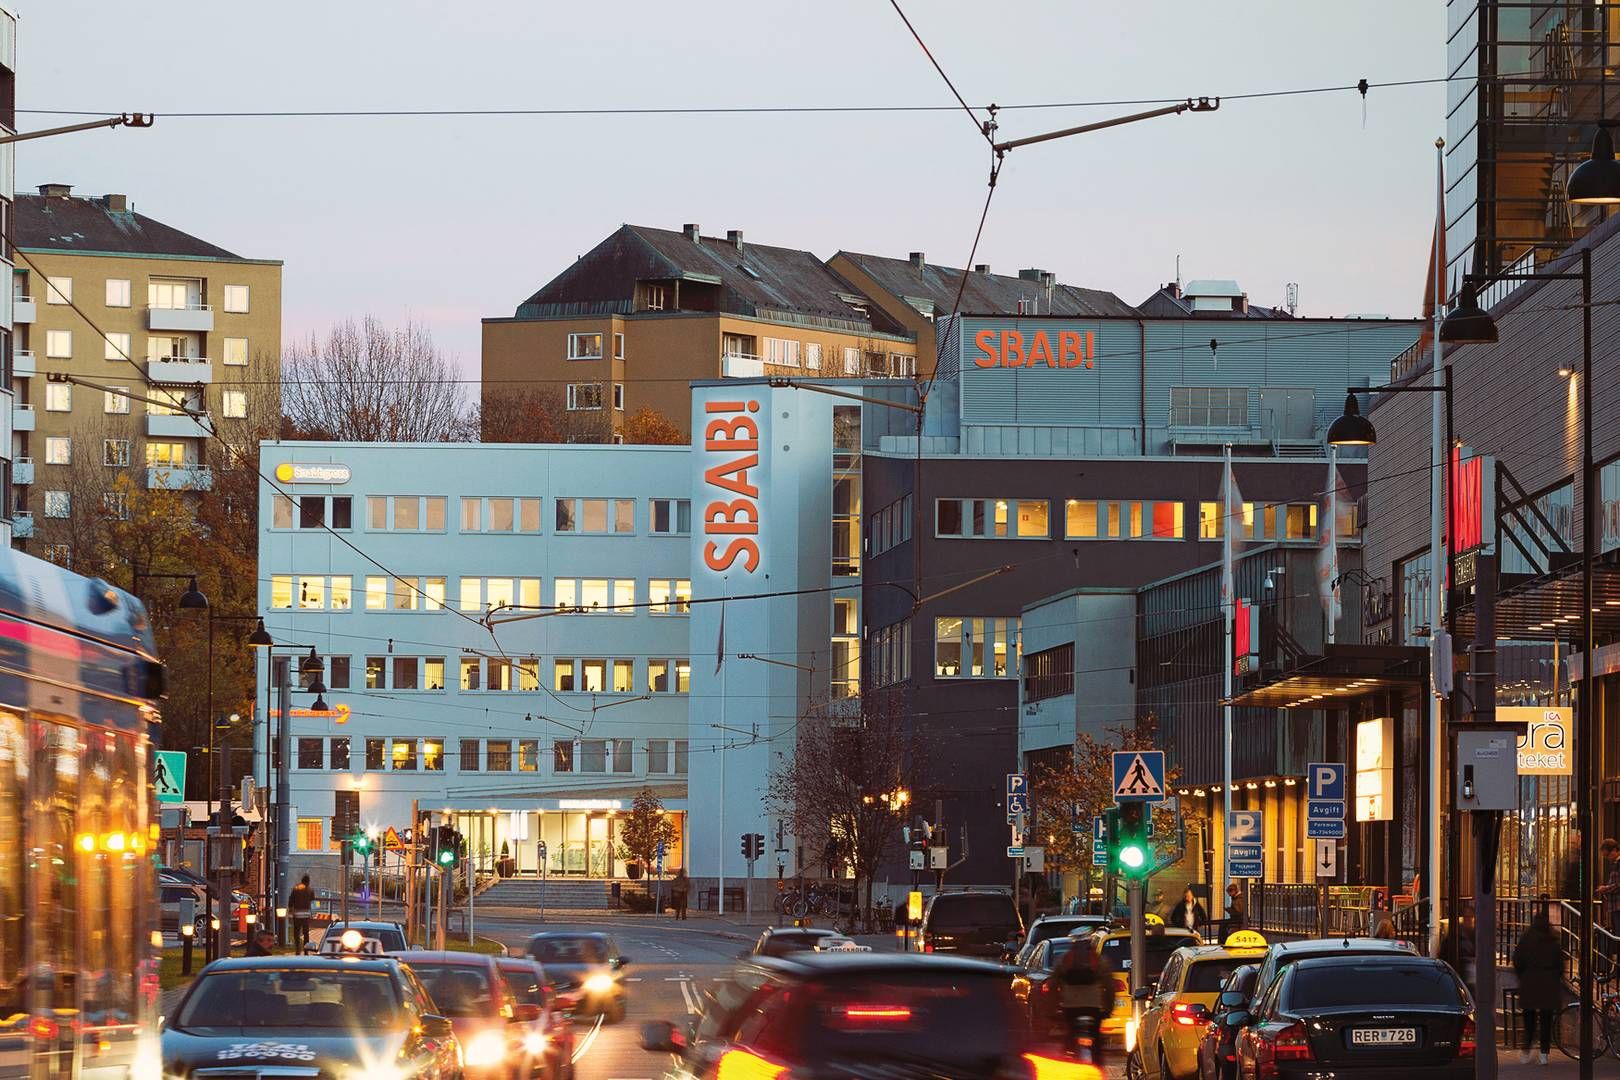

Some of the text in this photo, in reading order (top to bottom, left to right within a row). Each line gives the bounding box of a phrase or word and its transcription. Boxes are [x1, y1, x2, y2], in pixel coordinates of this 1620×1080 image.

[974, 329, 1095, 369] SBAB!
[704, 400, 760, 574] SBAB!
[1545, 711, 1561, 720] ICA
[1011, 776, 1023, 792] P
[1316, 768, 1337, 796] P
[1313, 806, 1339, 815] Avgift
[1233, 849, 1258, 857] Avgift
[1354, 1029, 1414, 1042] RER 726
